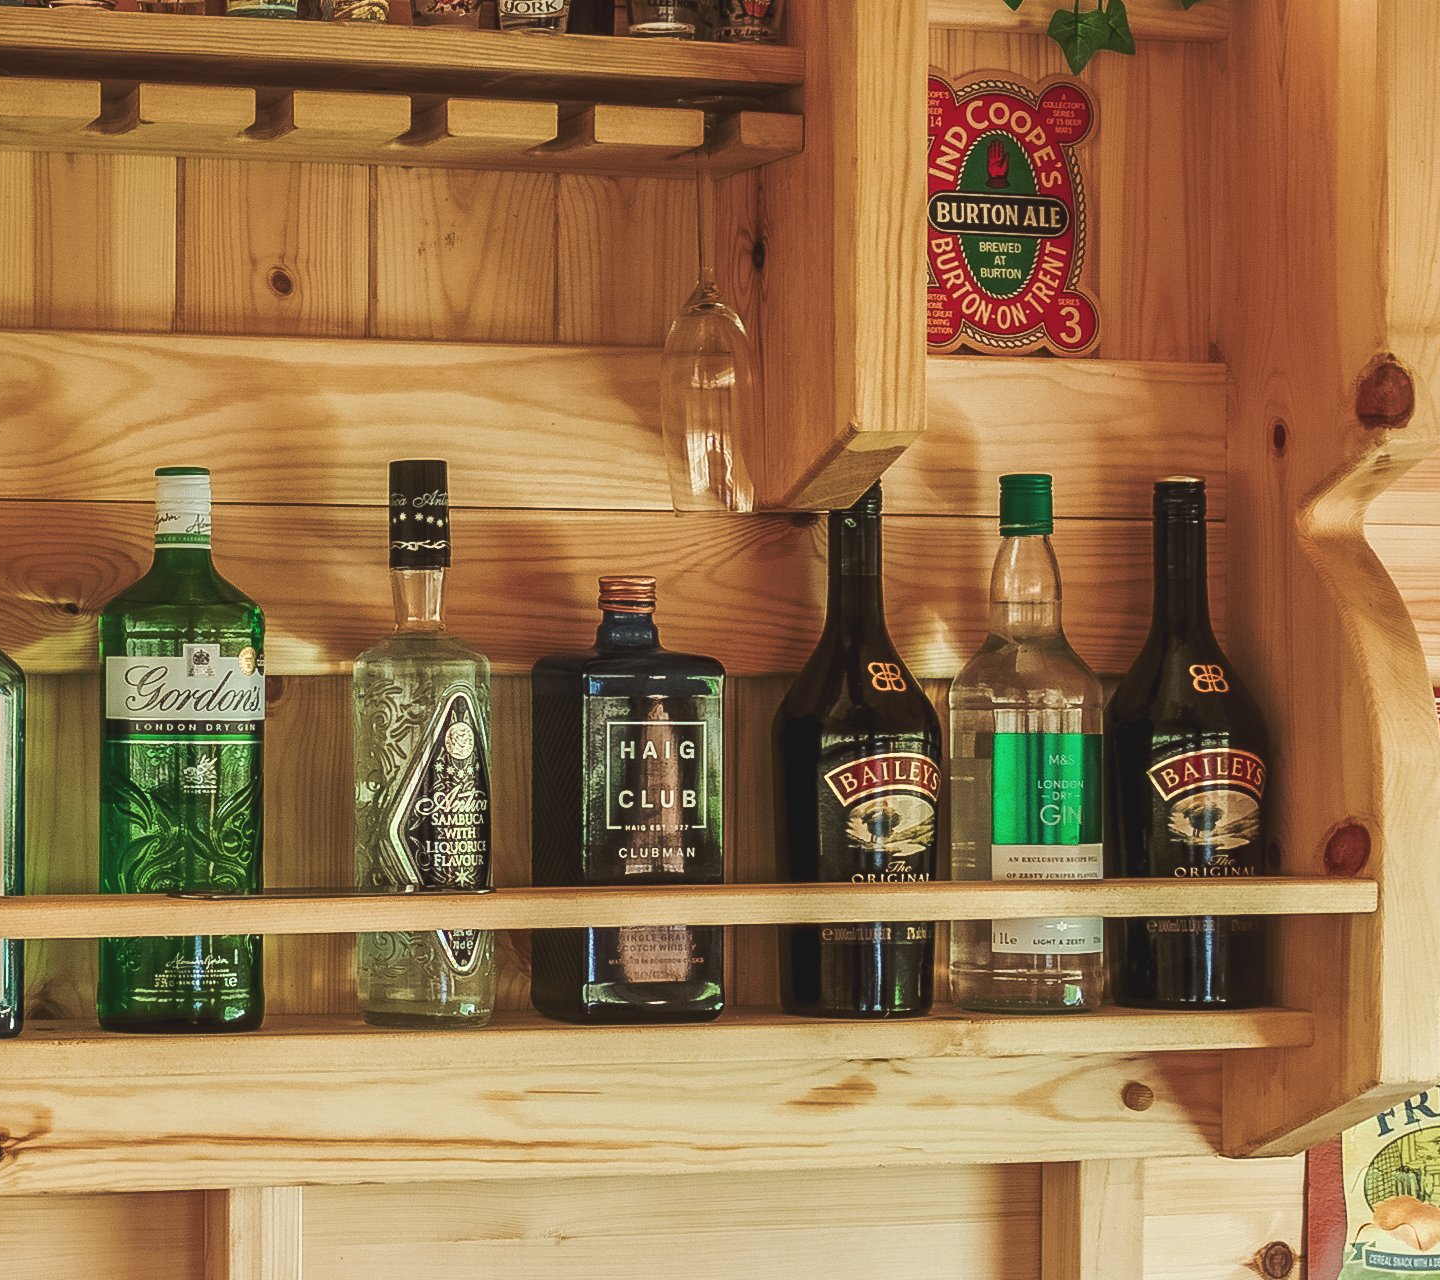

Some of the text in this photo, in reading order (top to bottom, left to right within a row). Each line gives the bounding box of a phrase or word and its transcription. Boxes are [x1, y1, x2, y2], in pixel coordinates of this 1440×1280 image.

[928, 100, 1063, 189] IND COOPE'S
[936, 200, 1062, 228] BURTON ALE
[979, 241, 1022, 254] BREWED
[994, 255, 1007, 266] AT
[980, 268, 1022, 280] BURTON
[1060, 306, 1082, 343] 3
[124, 665, 261, 712] Gordon's
[135, 723, 256, 731] LONDON DRY GIN
[620, 740, 695, 759] HAIG
[1049, 754, 1075, 766] M&S
[838, 760, 939, 794] BAILEYS
[1161, 756, 1264, 788] BAILEYS
[1037, 779, 1084, 789] LONDON
[618, 789, 697, 809] CLUB
[431, 813, 484, 825] SAMBUCA
[1040, 804, 1082, 825] GIN
[445, 827, 477, 839] WITH
[426, 840, 487, 854] LIQUORICE
[618, 847, 696, 858] CLUBMAN
[434, 854, 484, 867] FLAVOUR
[885, 860, 913, 873] The
[1208, 854, 1234, 866] The
[1369, 1254, 1391, 1266] CEREAL
[1393, 1257, 1412, 1267] SNACK
